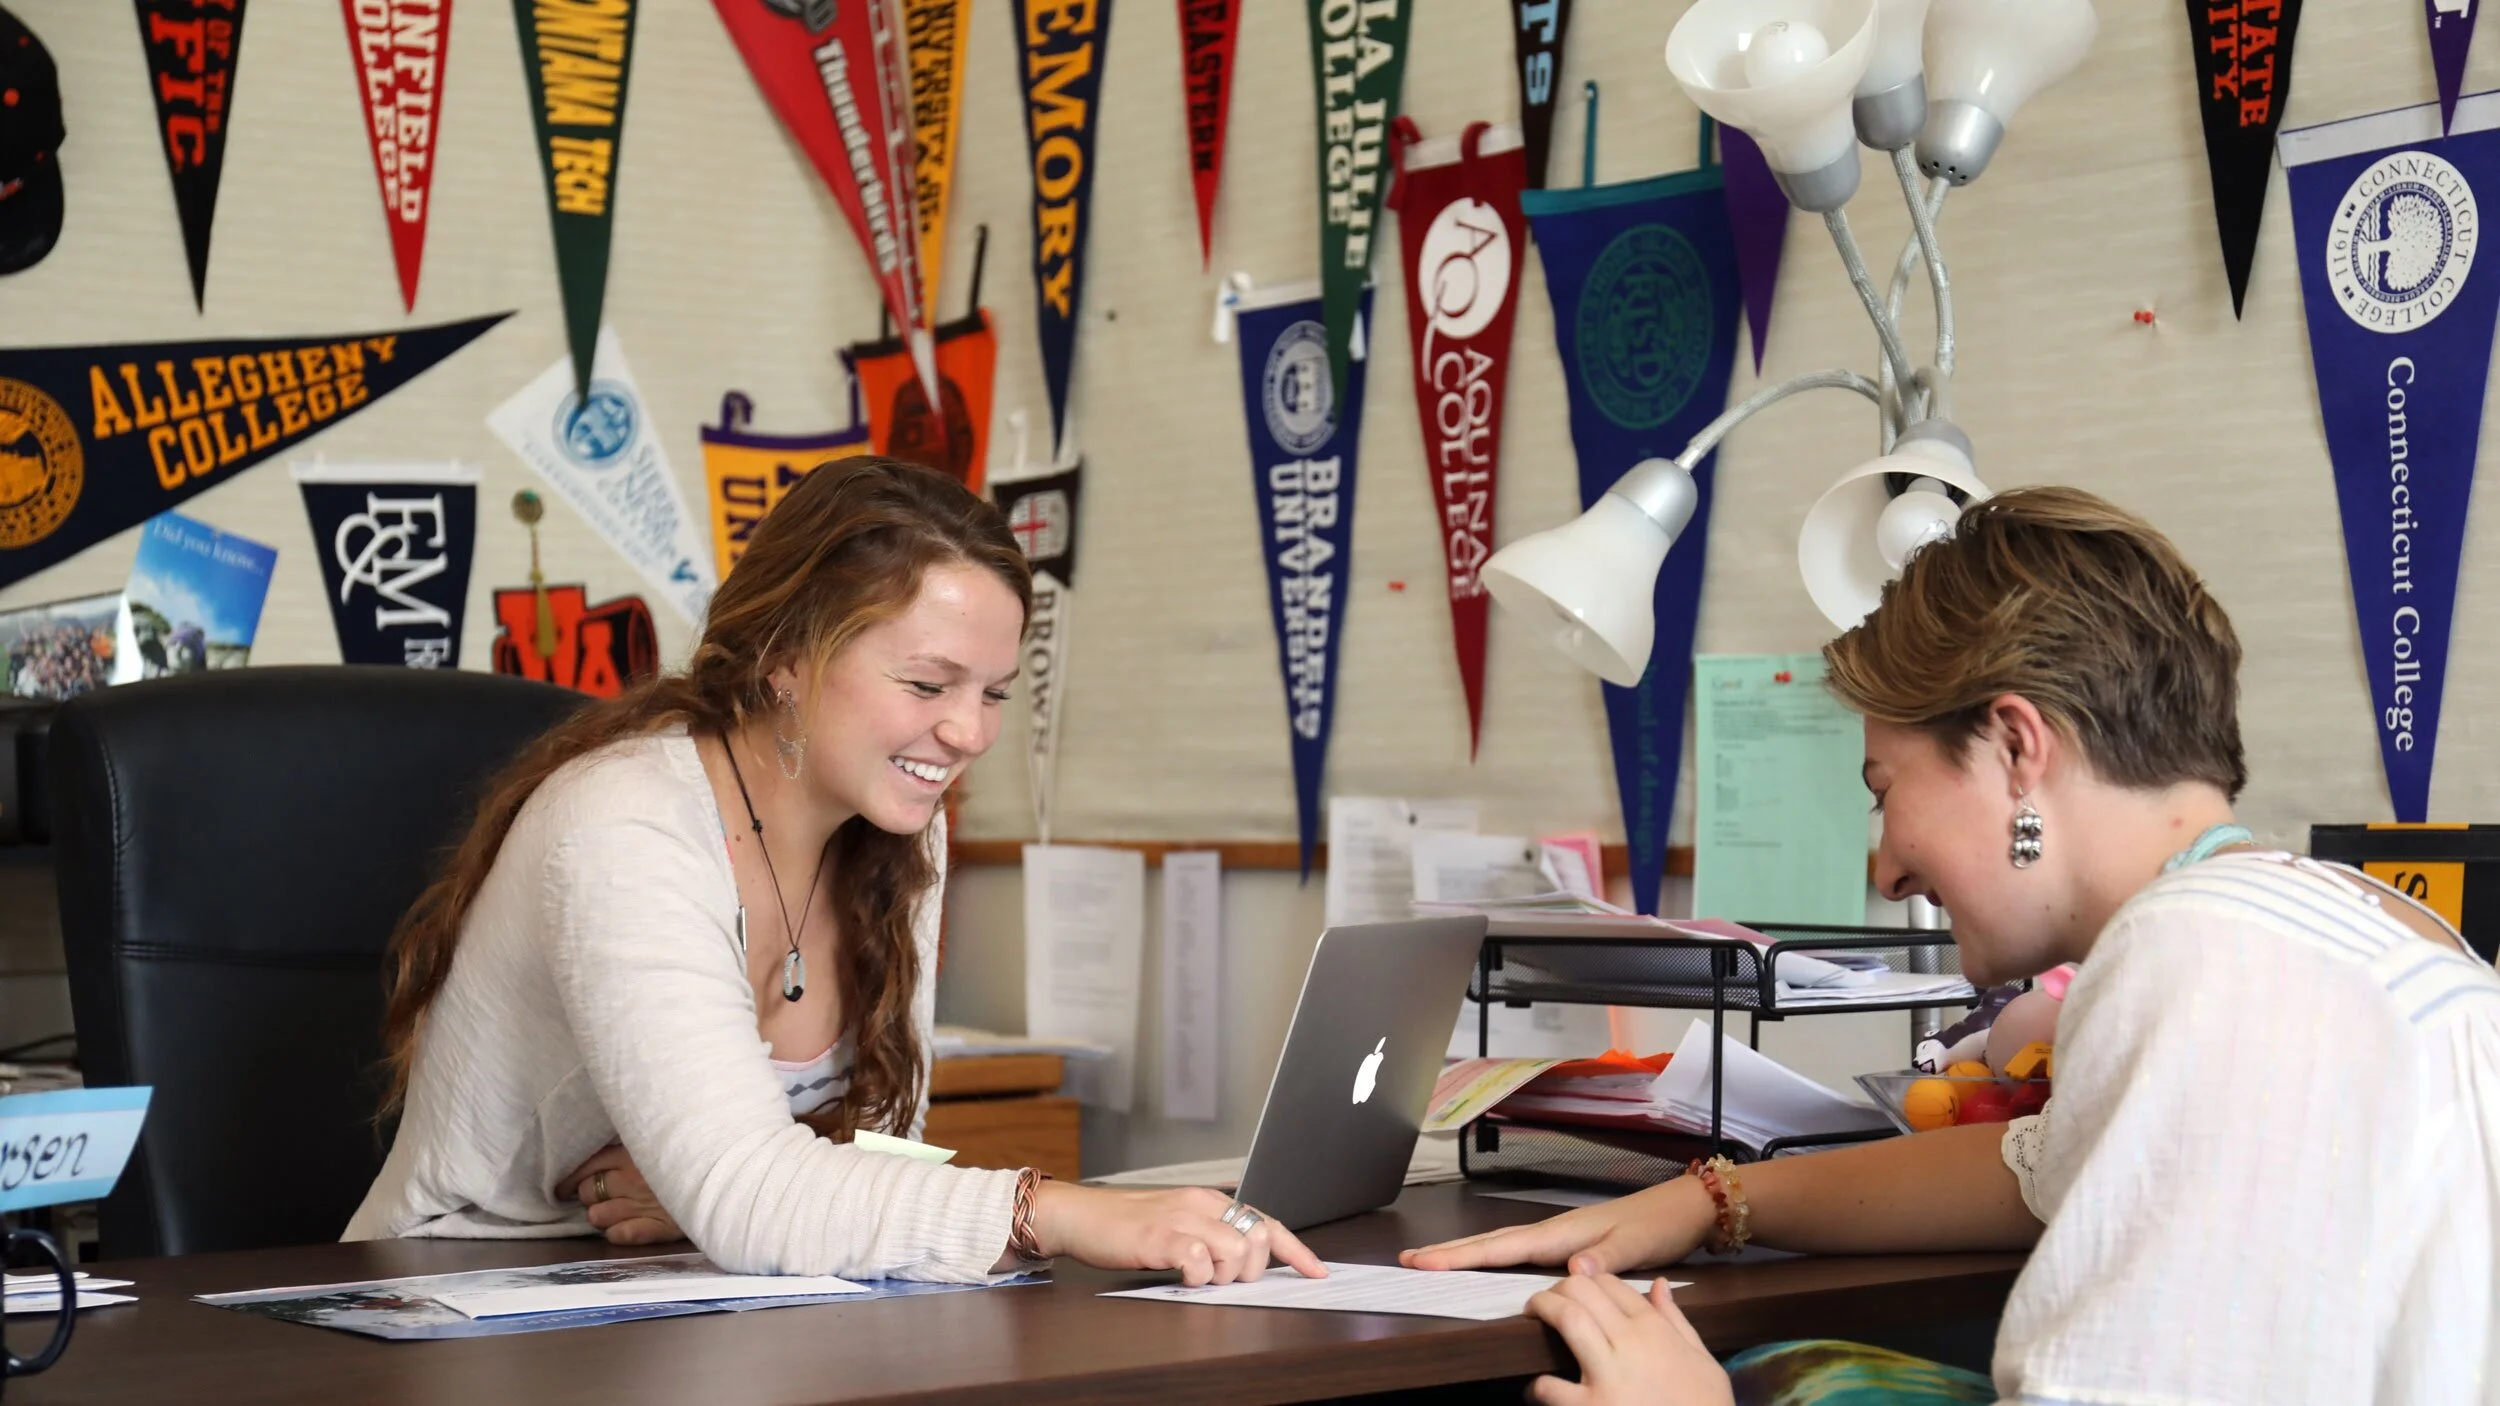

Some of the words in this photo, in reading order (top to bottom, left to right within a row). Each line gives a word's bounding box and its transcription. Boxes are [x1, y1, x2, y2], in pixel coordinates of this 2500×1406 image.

[149, 0, 207, 173] FIC
[813, 37, 899, 274] Thunderbirds
[1023, 0, 1097, 320] EMORY
[1187, 0, 1229, 172] EASTERN
[550, 135, 614, 217] TECH
[2358, 157, 2473, 265] CONNECTICUT
[2354, 276, 2456, 327] COLLEGE
[88, 335, 398, 440] ALLEGHENY
[147, 373, 370, 491] COLLEGE
[1432, 350, 1472, 601] COLLEGE
[2386, 355, 2418, 594] Connecticut
[1026, 590, 1057, 754] BROWN
[2385, 605, 2421, 753] College
[0, 1132, 89, 1192] rsen
